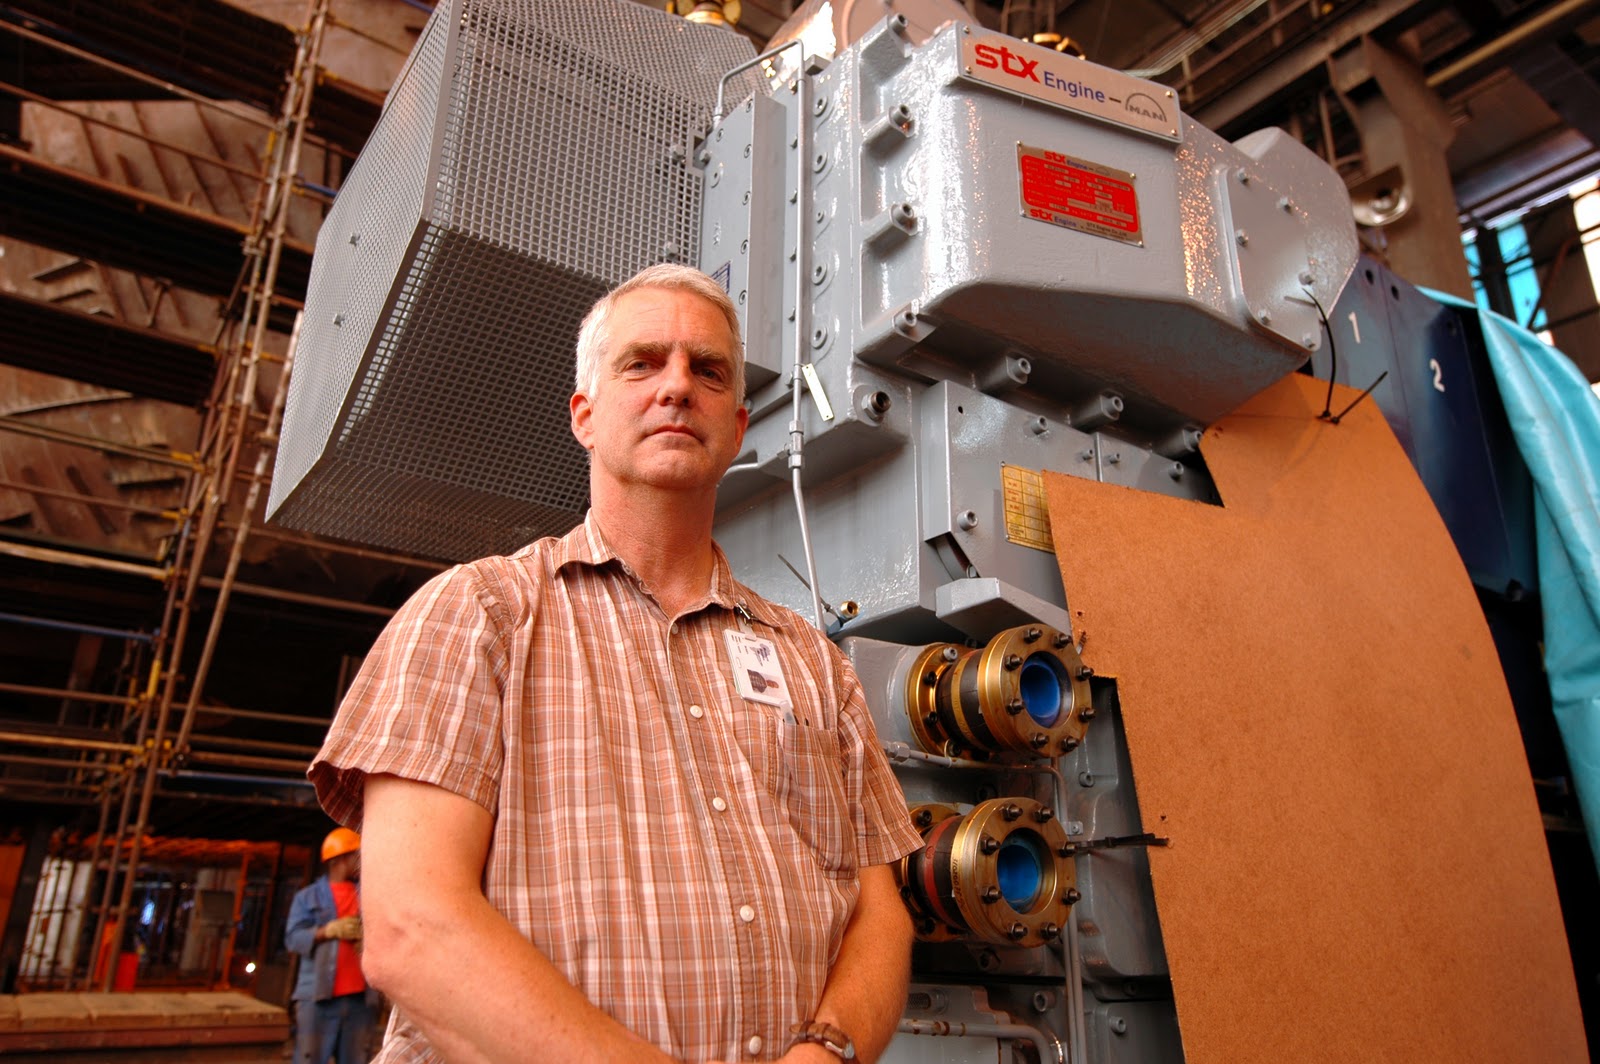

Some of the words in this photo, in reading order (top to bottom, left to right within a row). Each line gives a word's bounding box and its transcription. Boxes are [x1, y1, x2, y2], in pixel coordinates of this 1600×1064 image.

[974, 43, 1041, 84] stx
[1044, 71, 1106, 102] Engine
[1128, 104, 1166, 123] MAN
[1348, 311, 1361, 344] 1
[1429, 358, 1446, 393] 2
